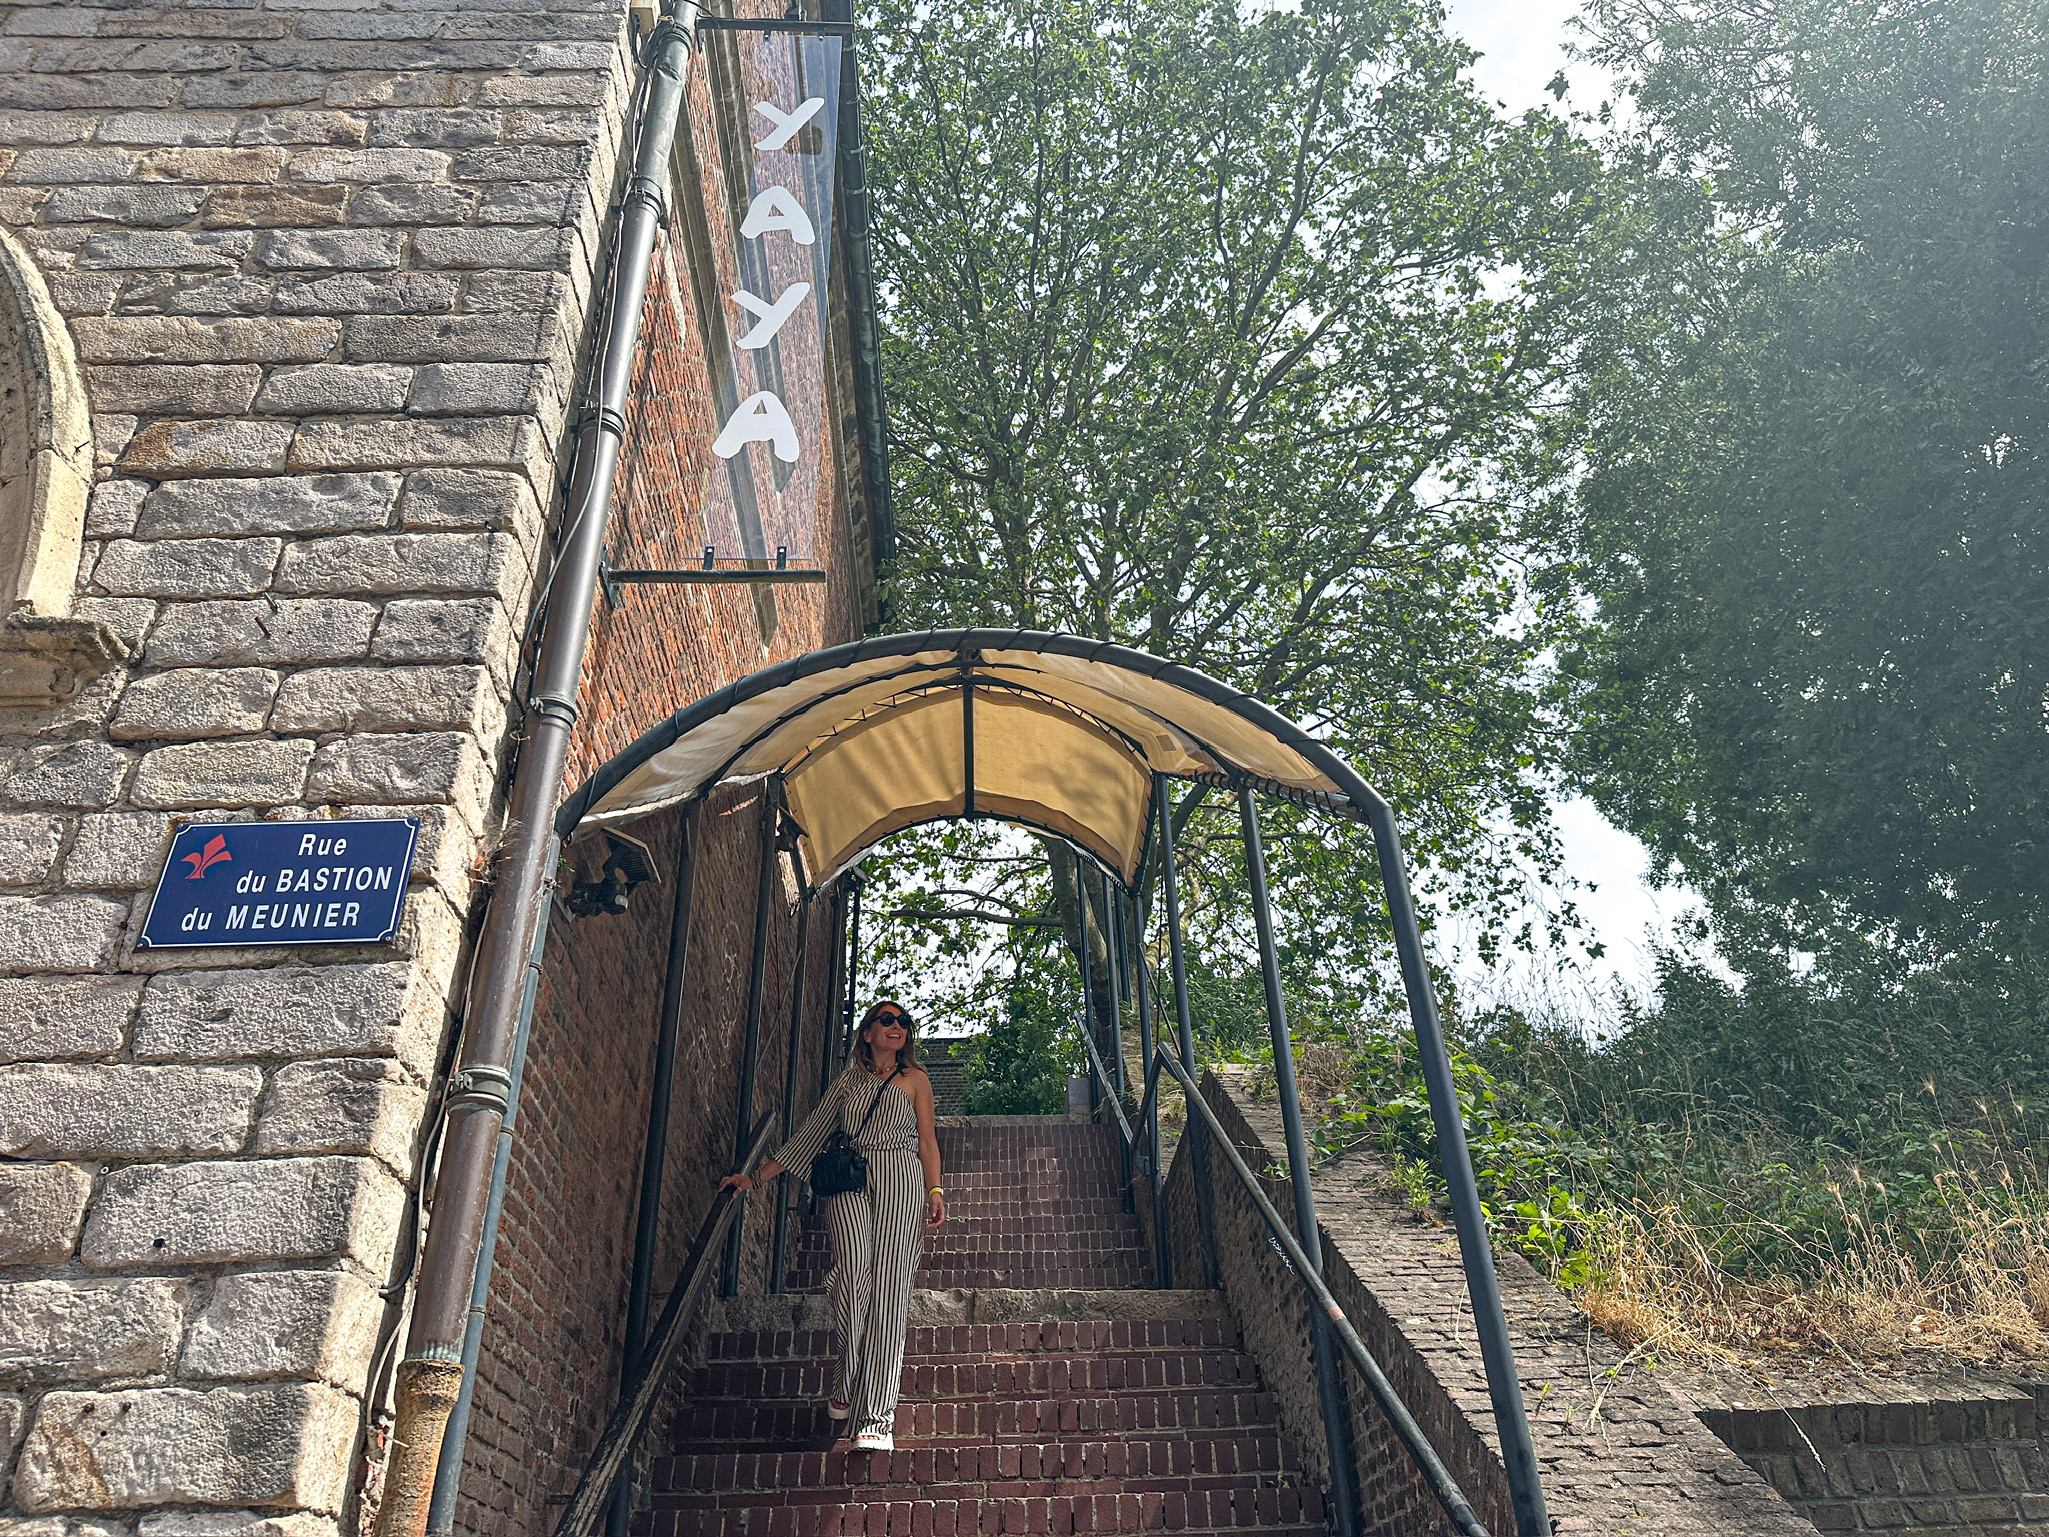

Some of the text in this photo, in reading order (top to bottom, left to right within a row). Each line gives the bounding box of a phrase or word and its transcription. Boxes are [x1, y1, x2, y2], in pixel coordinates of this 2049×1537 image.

[712, 97, 825, 463] YAYA
[298, 833, 347, 856] Rue
[236, 866, 393, 894] du BASTION
[181, 902, 360, 931] du MEUNIER
